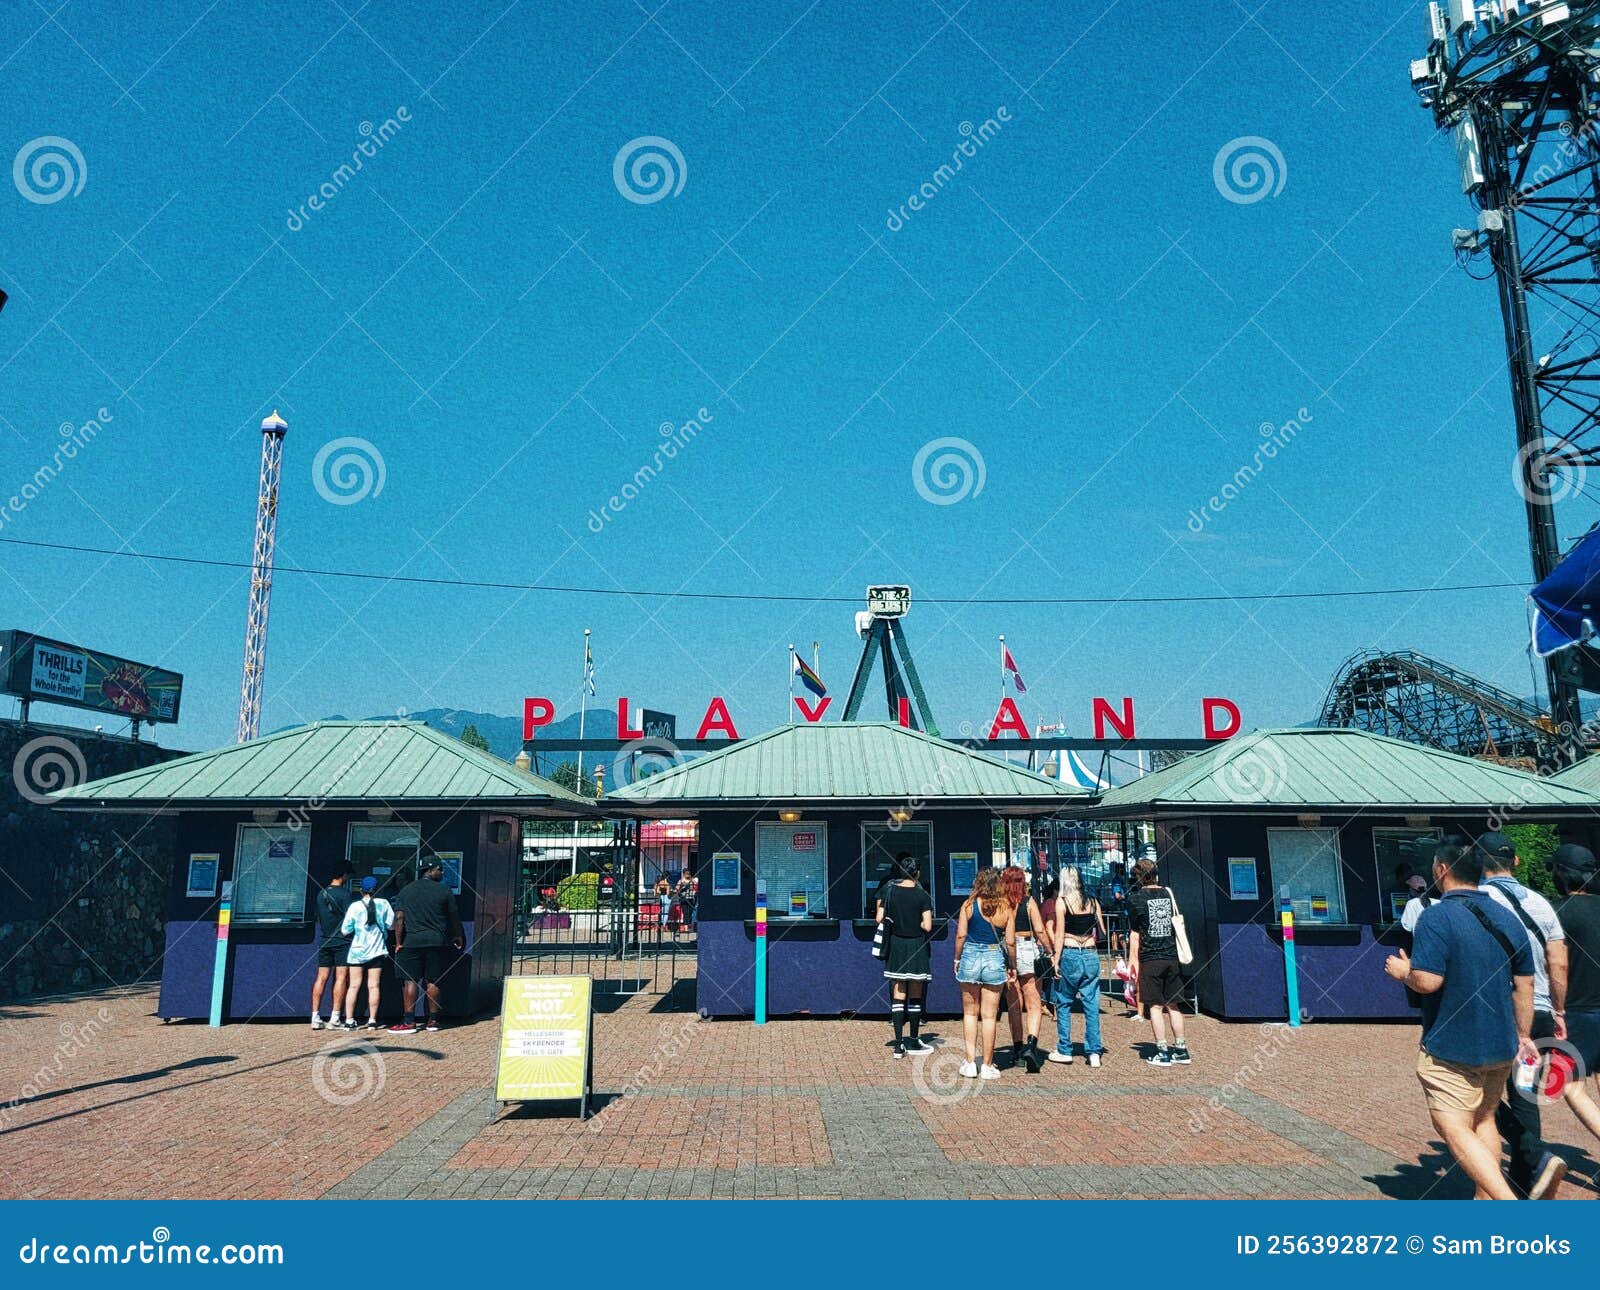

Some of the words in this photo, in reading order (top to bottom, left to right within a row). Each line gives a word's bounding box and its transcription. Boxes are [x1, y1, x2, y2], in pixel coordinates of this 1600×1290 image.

[881, 590, 897, 600] THE
[38, 650, 84, 675] THRILLS
[48, 669, 59, 681] for
[60, 671, 71, 683] the
[35, 677, 57, 691] Whole
[529, 999, 564, 1014] NOT
